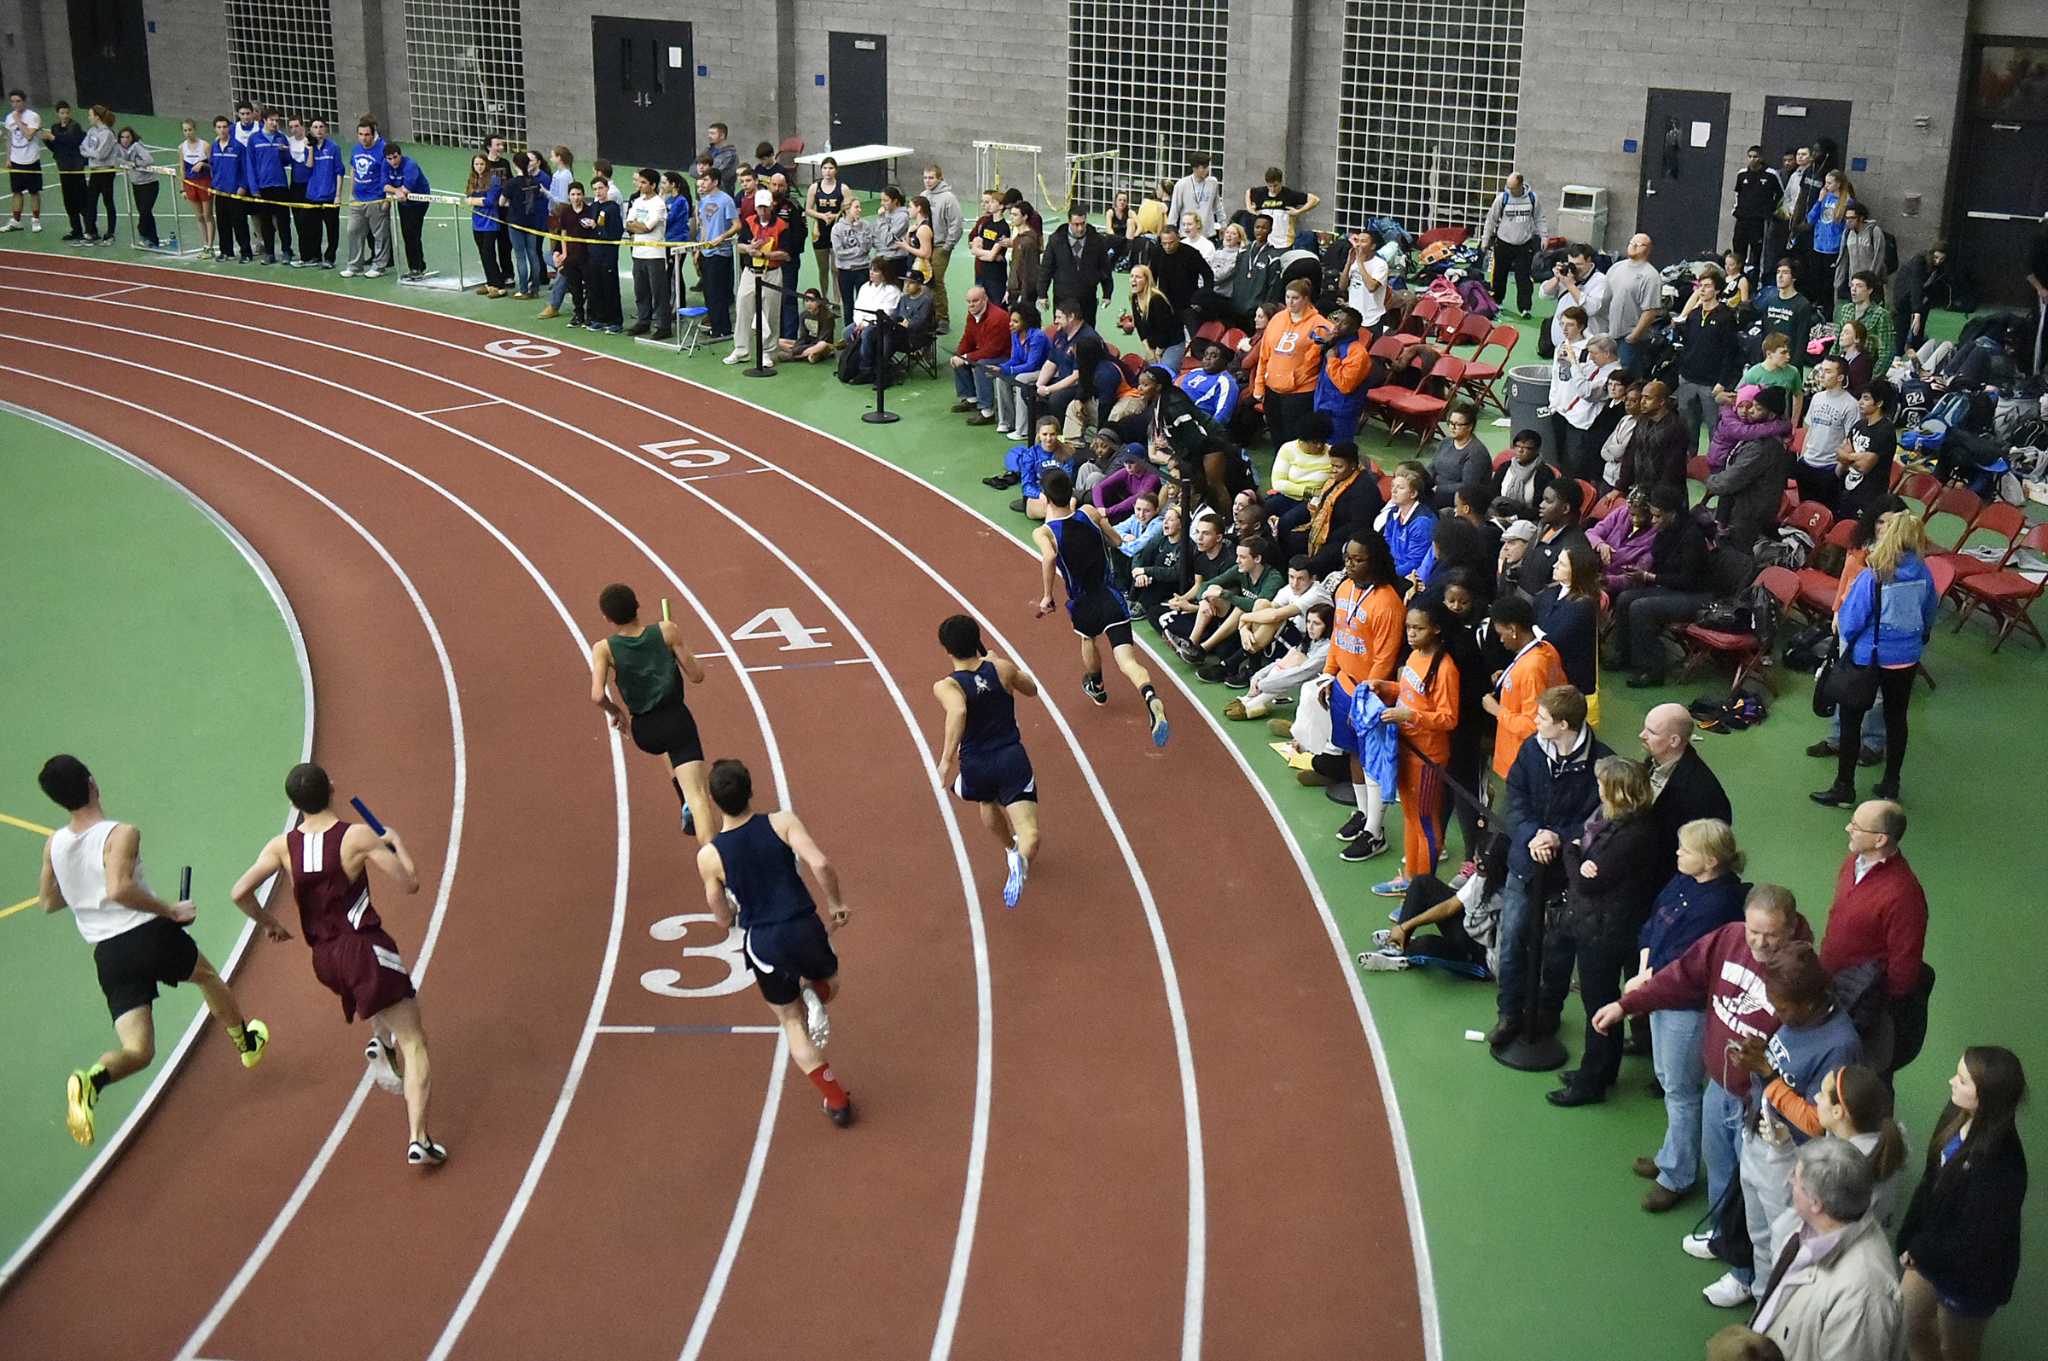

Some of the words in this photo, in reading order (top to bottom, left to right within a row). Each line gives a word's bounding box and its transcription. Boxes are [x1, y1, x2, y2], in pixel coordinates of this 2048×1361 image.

[484, 339, 561, 359] 6
[638, 438, 731, 468] 5
[730, 607, 832, 652] 4
[640, 913, 757, 998] 3
